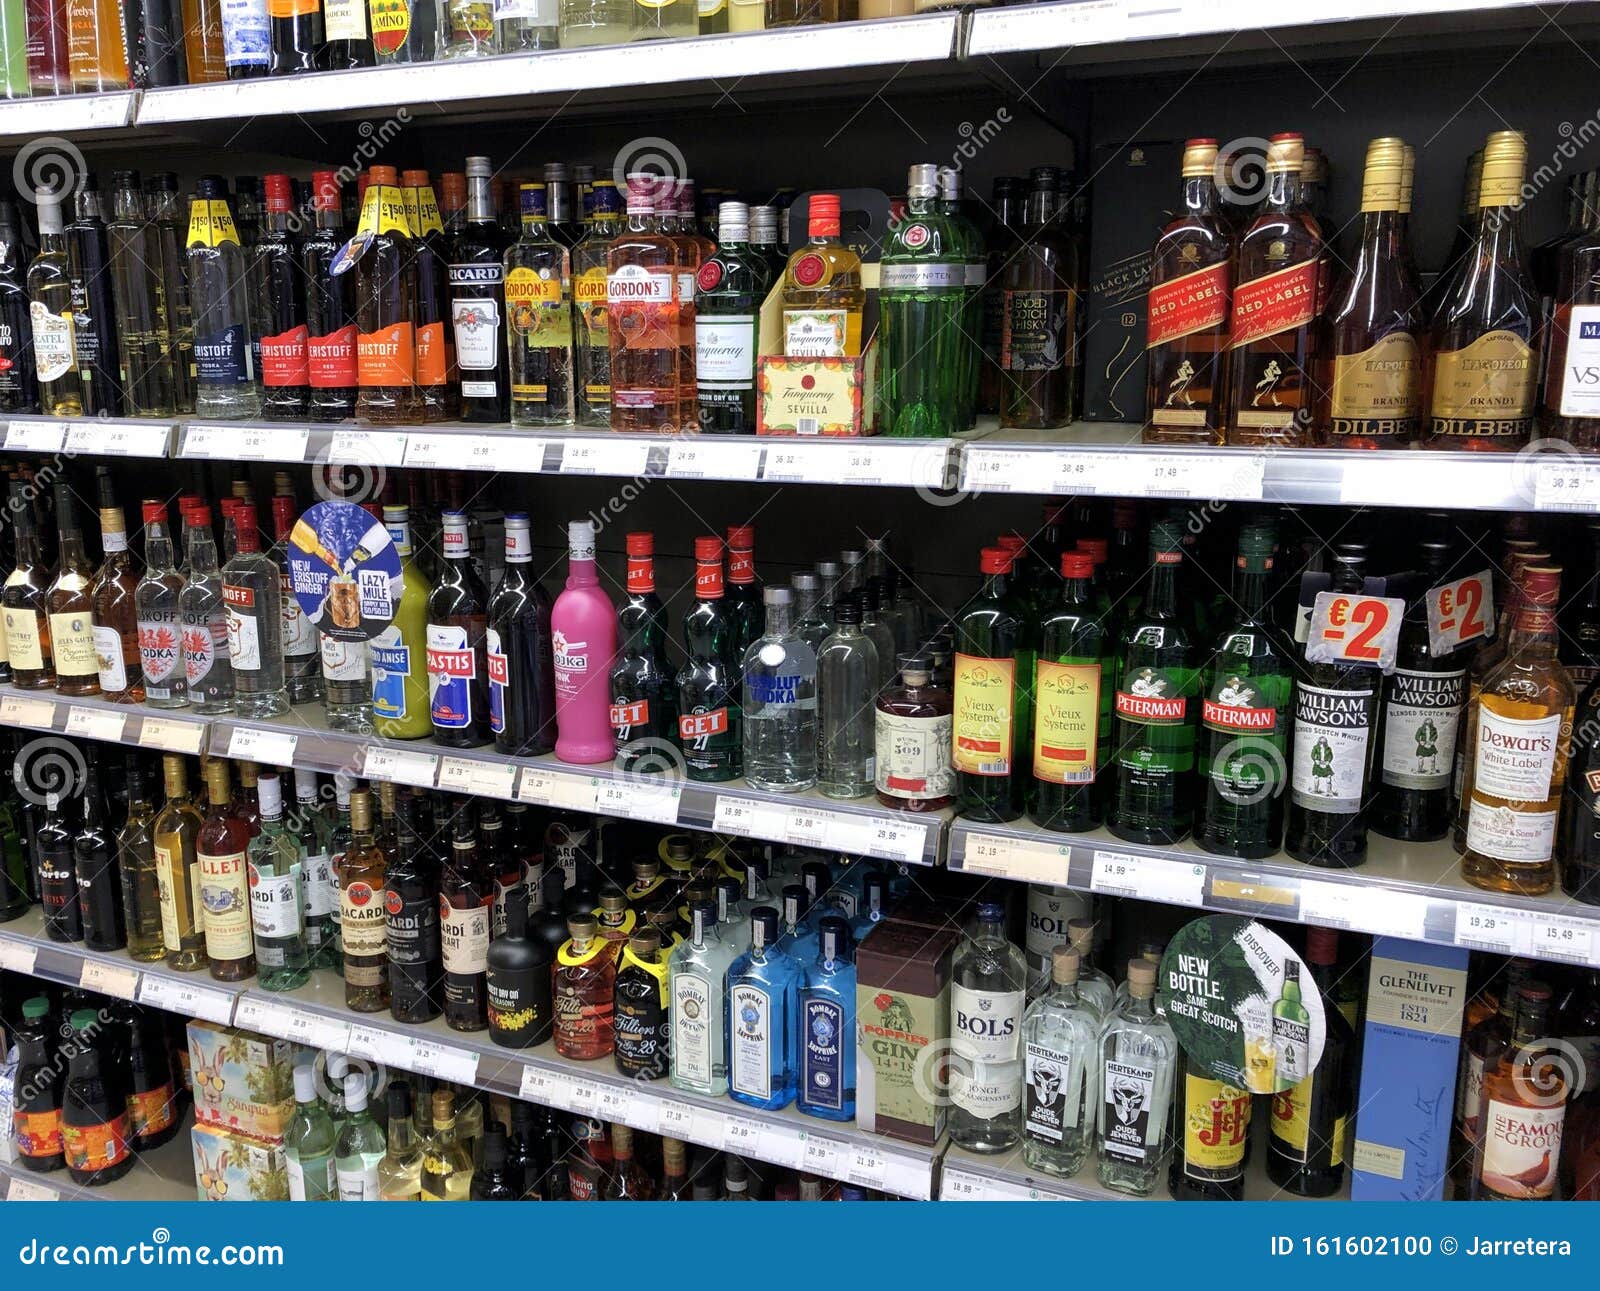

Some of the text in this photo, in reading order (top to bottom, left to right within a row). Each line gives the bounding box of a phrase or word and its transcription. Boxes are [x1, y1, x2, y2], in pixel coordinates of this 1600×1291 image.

[506, 281, 549, 297] GORDON'S
[578, 282, 607, 297] GORD
[610, 281, 660, 297] GORDON'S
[1093, 273, 1130, 293] BLACK
[1014, 300, 1047, 309] ENDED
[1151, 286, 1221, 317] RED LABEL
[1236, 284, 1311, 317] RED LABEL
[1123, 315, 1135, 325] 12
[35, 334, 65, 344] CATEL
[788, 333, 833, 347] Tanqueray
[194, 344, 232, 357] ERISTOFF
[262, 344, 304, 357] ERISTOFF
[309, 344, 352, 357] ERISTOFF
[357, 343, 399, 356] ERISTOFF
[782, 386, 835, 401] Tanqueray
[787, 404, 828, 415] SEVILLA
[1333, 419, 1411, 435] DILBE
[292, 560, 310, 573] NEW
[731, 559, 749, 572] GET
[293, 571, 328, 585] ERISTOFF
[361, 575, 385, 587] LAZY
[628, 569, 644, 580] GET
[698, 572, 716, 586] GET
[294, 582, 323, 595] GINGER
[363, 587, 388, 600] MULE
[143, 648, 175, 660] ODKA
[489, 659, 504, 676] TIS
[1396, 677, 1463, 693] WILLIAM
[964, 696, 995, 712] Vieux
[1118, 696, 1182, 717] PETERMAN
[1298, 690, 1364, 712] WILLIAM
[610, 704, 642, 724] GET
[959, 707, 1000, 724] Systeme
[1049, 705, 1081, 719] Vieux
[1205, 704, 1271, 725] PETERMAN
[1296, 707, 1368, 726] LAWSON'S
[1419, 710, 1444, 718] SCOTCH
[681, 712, 722, 735] GET
[1043, 715, 1087, 731] Systeme
[618, 725, 631, 741] 27
[1314, 728, 1365, 743] SCOTCH WHISKY
[1482, 724, 1551, 752] Dewar's
[693, 734, 708, 750] 27
[1484, 751, 1543, 769] White Label
[251, 889, 274, 903] ARDÍ
[441, 923, 465, 936] ARDÍ
[1030, 912, 1068, 935] BOL
[1243, 933, 1281, 977] DISCOVER
[1178, 954, 1209, 977] NEW
[1407, 970, 1428, 982] THE
[1169, 971, 1225, 1001] BOTTLE.
[1379, 975, 1456, 998] GLENLIVET
[677, 987, 706, 1005] BOMBAY
[737, 992, 763, 1008] BOMBAY
[1186, 994, 1207, 1009] SAME
[809, 1004, 837, 1018] BOMBAY
[1171, 1000, 1237, 1033] GREAT SCOTCH
[1400, 1011, 1428, 1024] 1824
[957, 1011, 1014, 1037] BOLS
[736, 1029, 765, 1042] SAPPHIRE
[864, 1024, 929, 1046] POPPIES
[638, 1040, 655, 1055] 28
[808, 1042, 838, 1055] SAPPHIRE
[872, 1039, 919, 1061] GIN
[1028, 1044, 1069, 1063] HERTEKAMP
[814, 1055, 831, 1063] EAST
[1108, 1063, 1153, 1078] HERTEKAMP
[1036, 1106, 1056, 1118] OUDE
[1115, 1125, 1138, 1136] OUDE
[1495, 1115, 1506, 1139] THE
[1110, 1131, 1143, 1144] JENEVER
